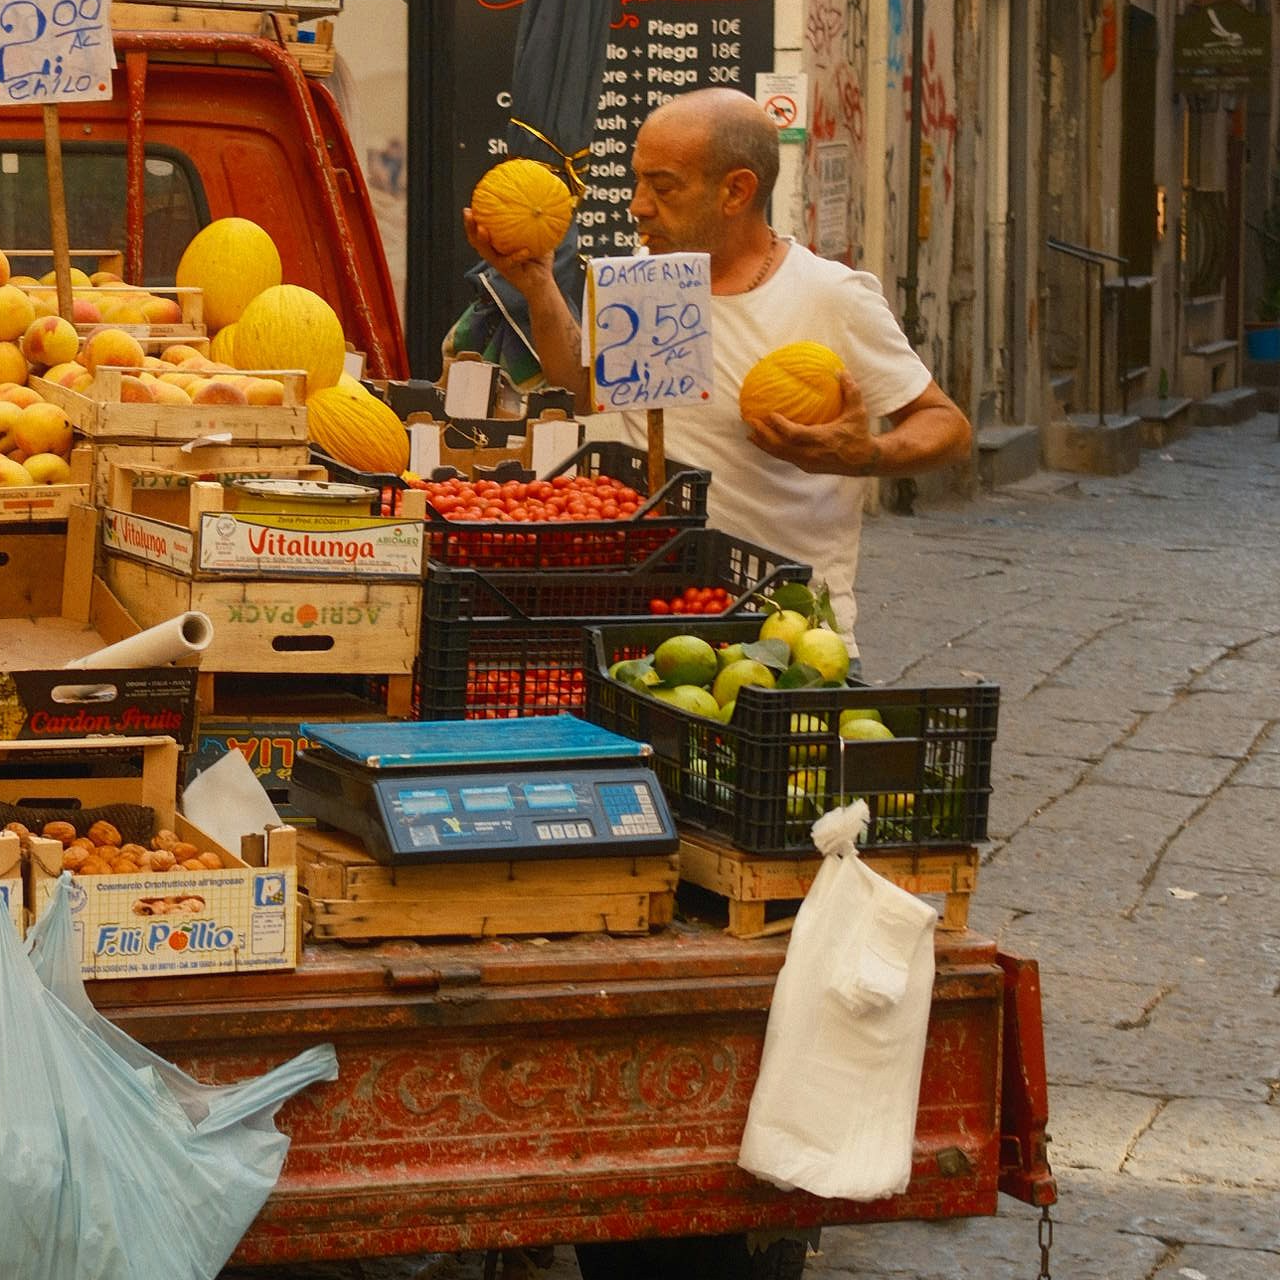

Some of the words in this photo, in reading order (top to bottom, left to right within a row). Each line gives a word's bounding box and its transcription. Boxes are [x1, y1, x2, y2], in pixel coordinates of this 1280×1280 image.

[648, 20, 698, 38] Piega
[712, 19, 741, 35] 10€
[648, 43, 698, 62] Piega
[712, 43, 741, 58] 18€
[648, 66, 698, 86] Piega
[709, 66, 741, 82] 30€
[121, 516, 167, 557] Vitalunga
[248, 527, 375, 563] Vitalunga
[96, 882, 144, 892] Commercio
[144, 879, 197, 890] Ortofrutticolo
